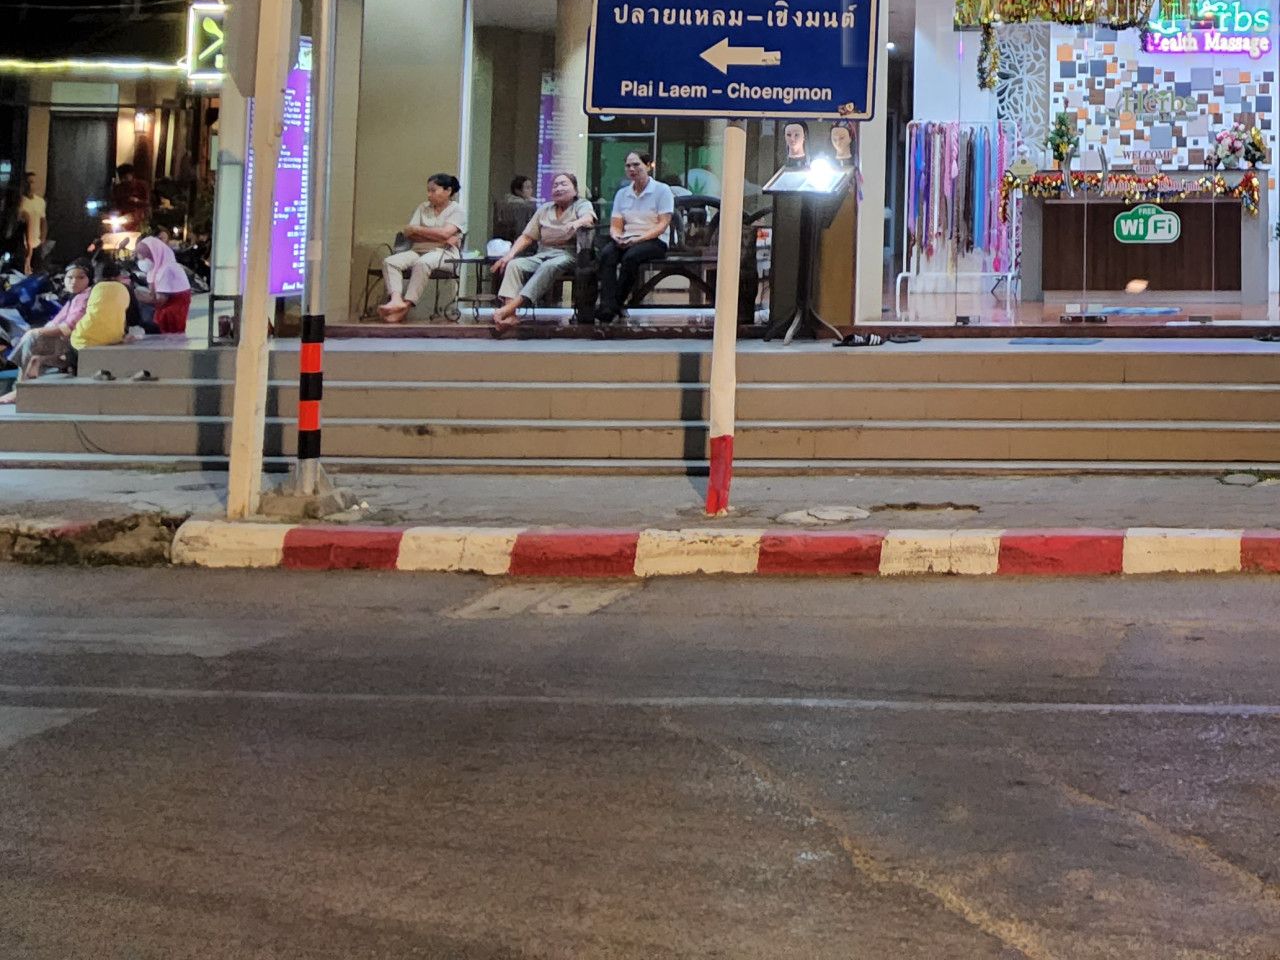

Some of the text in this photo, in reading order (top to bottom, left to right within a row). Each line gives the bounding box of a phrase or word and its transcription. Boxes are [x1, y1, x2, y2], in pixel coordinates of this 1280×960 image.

[1203, 31, 1271, 59] Massage
[620, 80, 654, 98] Plai
[657, 81, 708, 99] Laem
[726, 82, 833, 104] Choengmon
[1138, 207, 1157, 215] FREE
